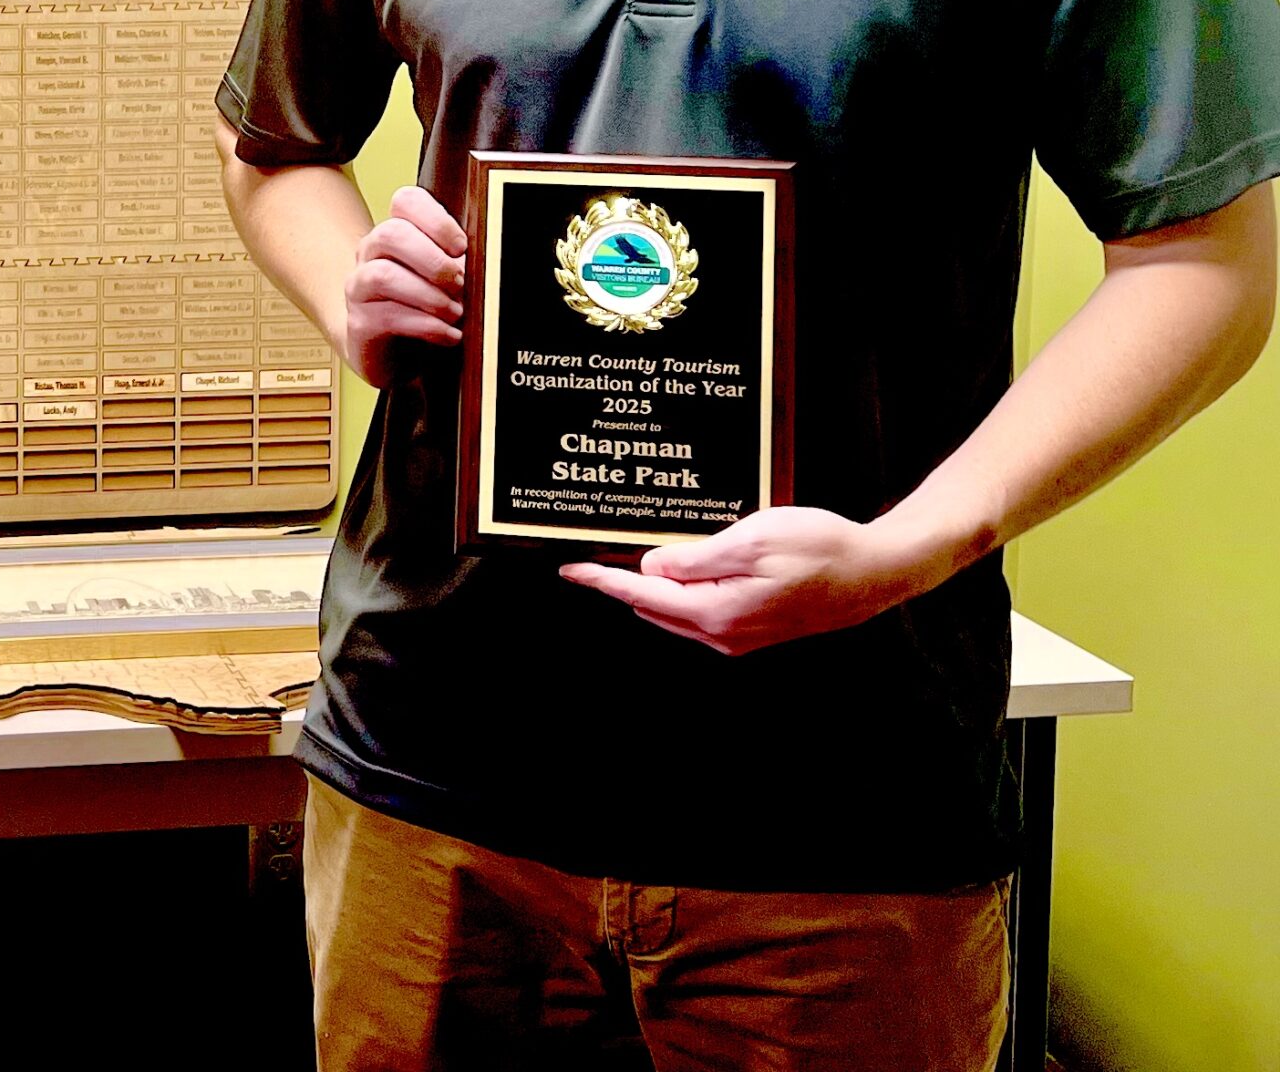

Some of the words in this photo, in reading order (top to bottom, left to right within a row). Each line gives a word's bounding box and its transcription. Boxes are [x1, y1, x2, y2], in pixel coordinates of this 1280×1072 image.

[516, 350, 583, 367] Warren
[588, 354, 657, 375] County
[662, 358, 741, 376] Tourism
[510, 370, 634, 392] Organization
[639, 377, 659, 394] of
[664, 379, 697, 395] the
[701, 381, 748, 398] Year
[602, 397, 653, 415] 2025
[592, 419, 647, 431] Presented
[650, 422, 662, 432] to
[559, 433, 693, 460] Chapman
[551, 461, 626, 484] State
[634, 466, 701, 489] Park
[510, 486, 522, 496] In
[524, 488, 588, 502] recognition
[590, 491, 604, 503] of
[605, 493, 664, 507] exemplary
[666, 497, 727, 510] promotion
[728, 499, 743, 511] of
[512, 499, 551, 511] Warren
[660, 508, 682, 519] and
[684, 509, 699, 520] its
